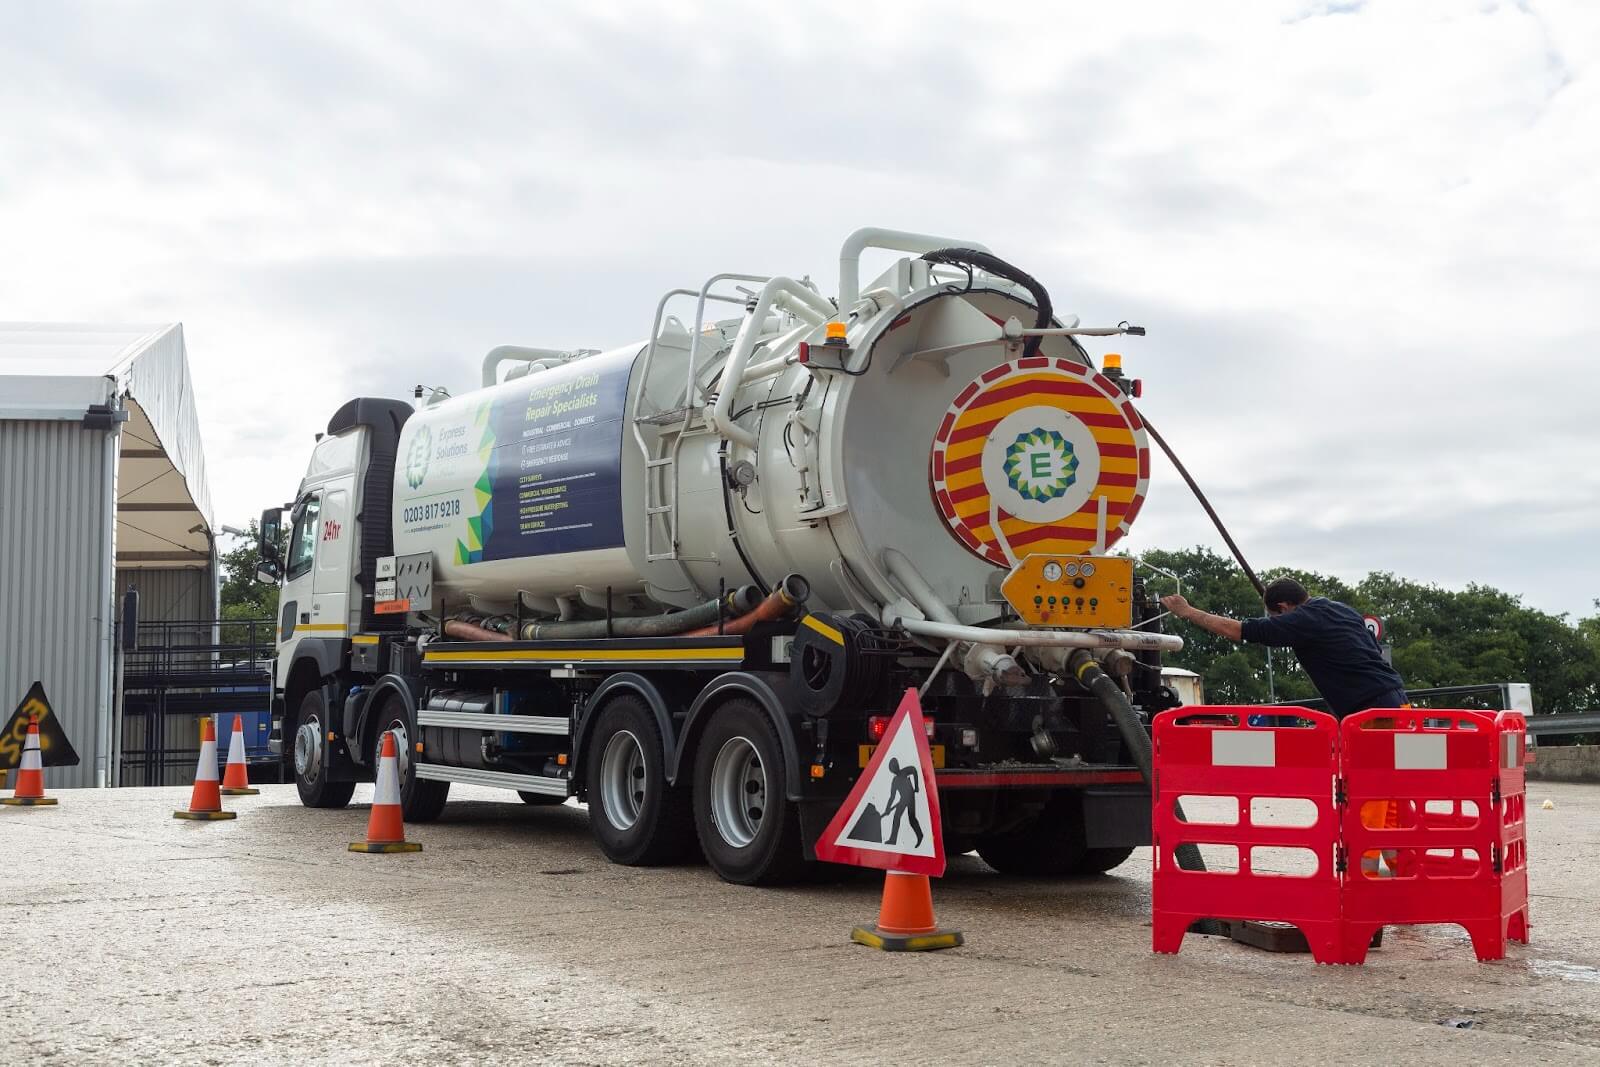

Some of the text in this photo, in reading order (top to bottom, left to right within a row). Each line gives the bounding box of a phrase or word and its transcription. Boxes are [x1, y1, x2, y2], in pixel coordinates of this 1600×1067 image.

[529, 372, 600, 402] Emergency Drain
[526, 392, 598, 422] Repair Specialists
[439, 425, 466, 443] Express
[436, 443, 468, 460] Solutions
[1030, 452, 1052, 479] E
[403, 499, 460, 524] 0203 817 9218
[323, 519, 341, 541] 24hr
